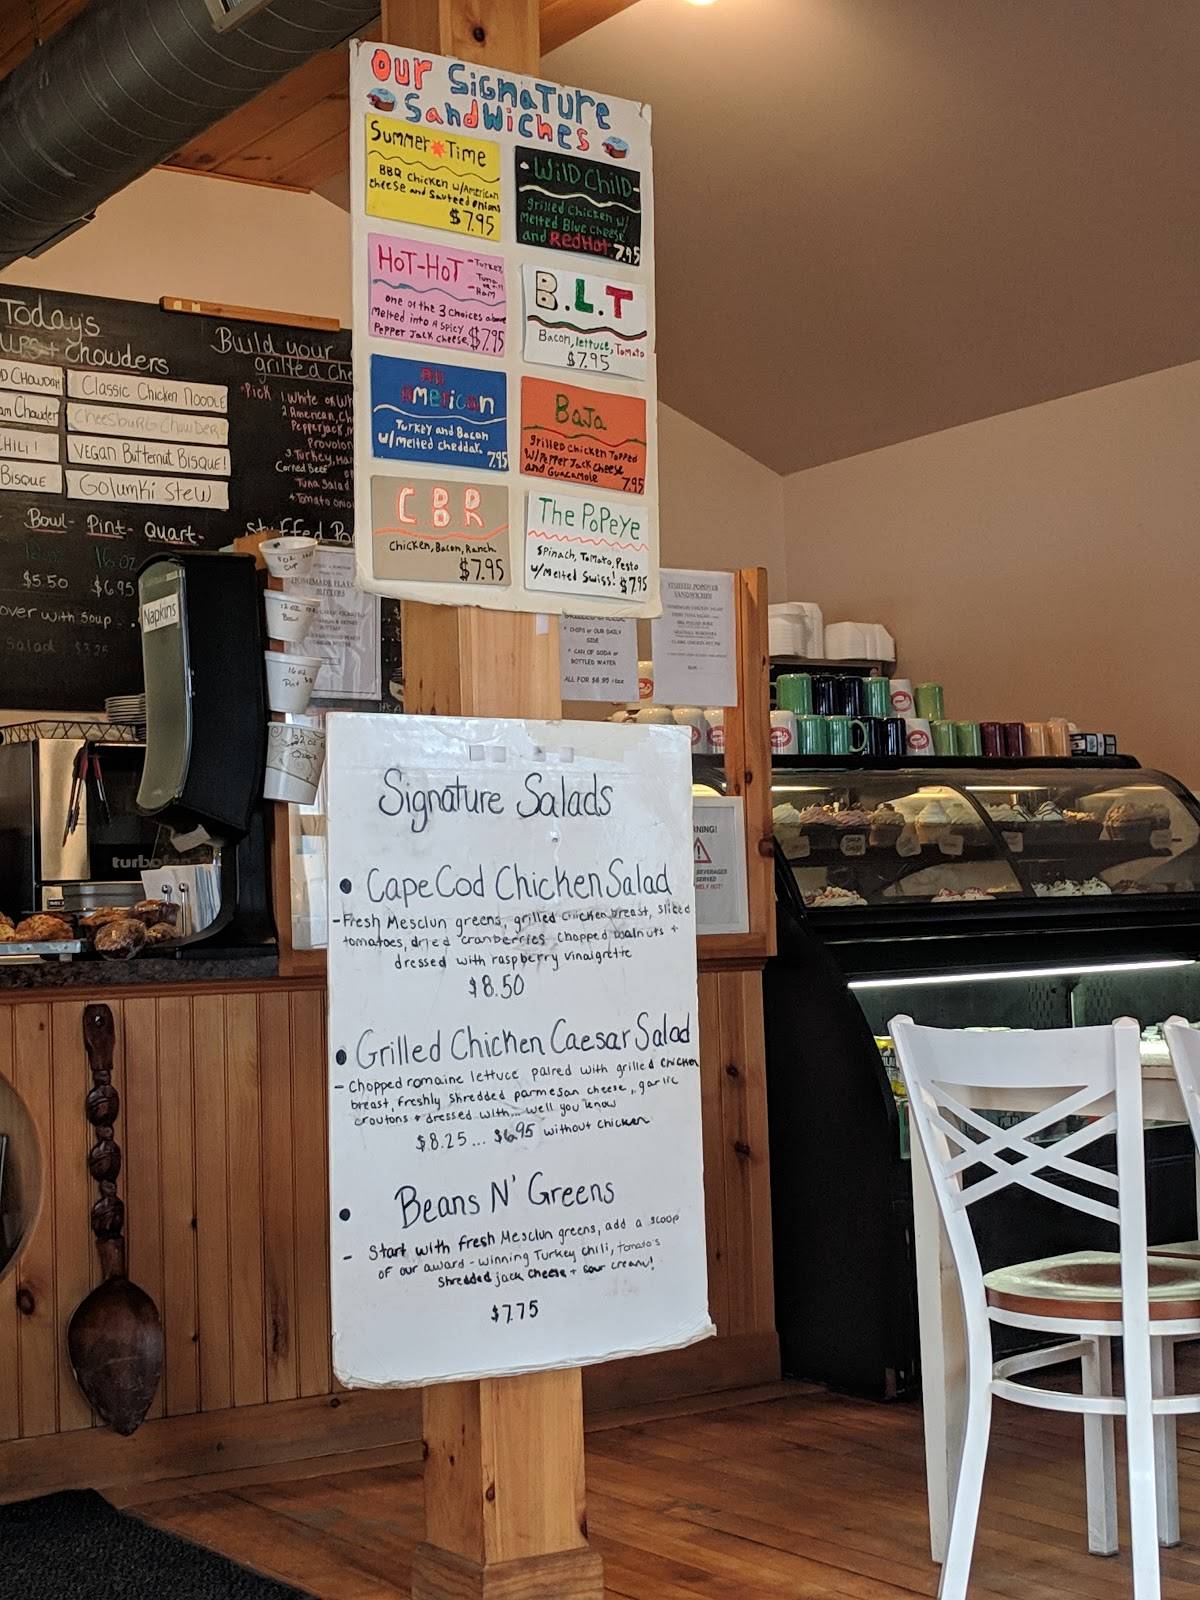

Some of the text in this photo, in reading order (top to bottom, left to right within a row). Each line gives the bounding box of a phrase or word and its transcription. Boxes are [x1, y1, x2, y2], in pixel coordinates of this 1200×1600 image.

[370, 48, 432, 90] Our
[371, 120, 487, 167] Summer Time
[379, 164, 402, 178] BBQ
[409, 187, 426, 196] and
[449, 207, 495, 236] $7.95
[562, 218, 587, 233] Blue
[522, 229, 640, 264] and 7.95
[385, 296, 446, 317] one of the 3
[409, 313, 429, 326] into
[210, 326, 333, 361] Build your
[468, 326, 505, 352] $7.95
[538, 329, 574, 349] Bacon,
[575, 336, 613, 354] lettuce,
[65, 337, 170, 376] Chowders
[567, 352, 610, 370] $7.95
[82, 376, 178, 403] Classic Chicken
[435, 426, 454, 436] and
[457, 426, 488, 440] Bacon
[487, 451, 508, 468] 7.95
[622, 477, 644, 494] 7.95
[539, 497, 575, 526] The
[435, 542, 465, 555] Bacon,
[460, 558, 504, 581] $7.95
[616, 557, 639, 571] Pesto
[583, 571, 616, 586] Swiss!
[620, 576, 647, 594] $7.95
[41, 611, 75, 623] with
[144, 600, 177, 625] Napkins
[379, 768, 613, 832] Signature Salads
[367, 858, 672, 908] Cape Cod Chicken Salad
[387, 915, 447, 929] Mesclun
[455, 915, 507, 937] greens,
[514, 911, 556, 933] grilled
[611, 906, 652, 920] breast,
[658, 904, 691, 914] sliced
[343, 936, 407, 952] tomatoes,
[411, 936, 450, 948] dried
[614, 927, 664, 939] walnuts
[394, 948, 632, 971] dressed with raspberry vinaigrette
[468, 974, 525, 999] $8.50
[356, 1012, 690, 1069] Grilled Chicken Caesar Salad
[407, 1075, 464, 1088] romaine
[470, 1069, 520, 1082] lettuce
[532, 1064, 572, 1082] paired
[580, 1064, 608, 1075] with
[617, 1059, 654, 1078] grilled
[351, 1098, 394, 1112] breast,
[398, 1094, 441, 1111] freshly
[514, 1089, 580, 1102] parmesan
[639, 1075, 679, 1095] garlic
[354, 1115, 408, 1126] croutons
[426, 1110, 472, 1123] dressed
[560, 1105, 580, 1117] you
[585, 1100, 617, 1109] know
[544, 1122, 591, 1136] without
[394, 1185, 480, 1229] Beans
[528, 1171, 615, 1207] Greens
[369, 1243, 407, 1261] Start
[416, 1240, 450, 1257] with
[500, 1228, 552, 1245] Mesclun
[559, 1225, 601, 1245] greens,
[605, 1219, 626, 1231] add
[636, 1220, 642, 1228] a
[650, 1215, 680, 1225] scoop
[378, 1266, 393, 1280] of
[400, 1265, 418, 1276] our
[535, 1249, 577, 1262] Turkey
[582, 1243, 614, 1257] chili,
[495, 1270, 524, 1287] jack
